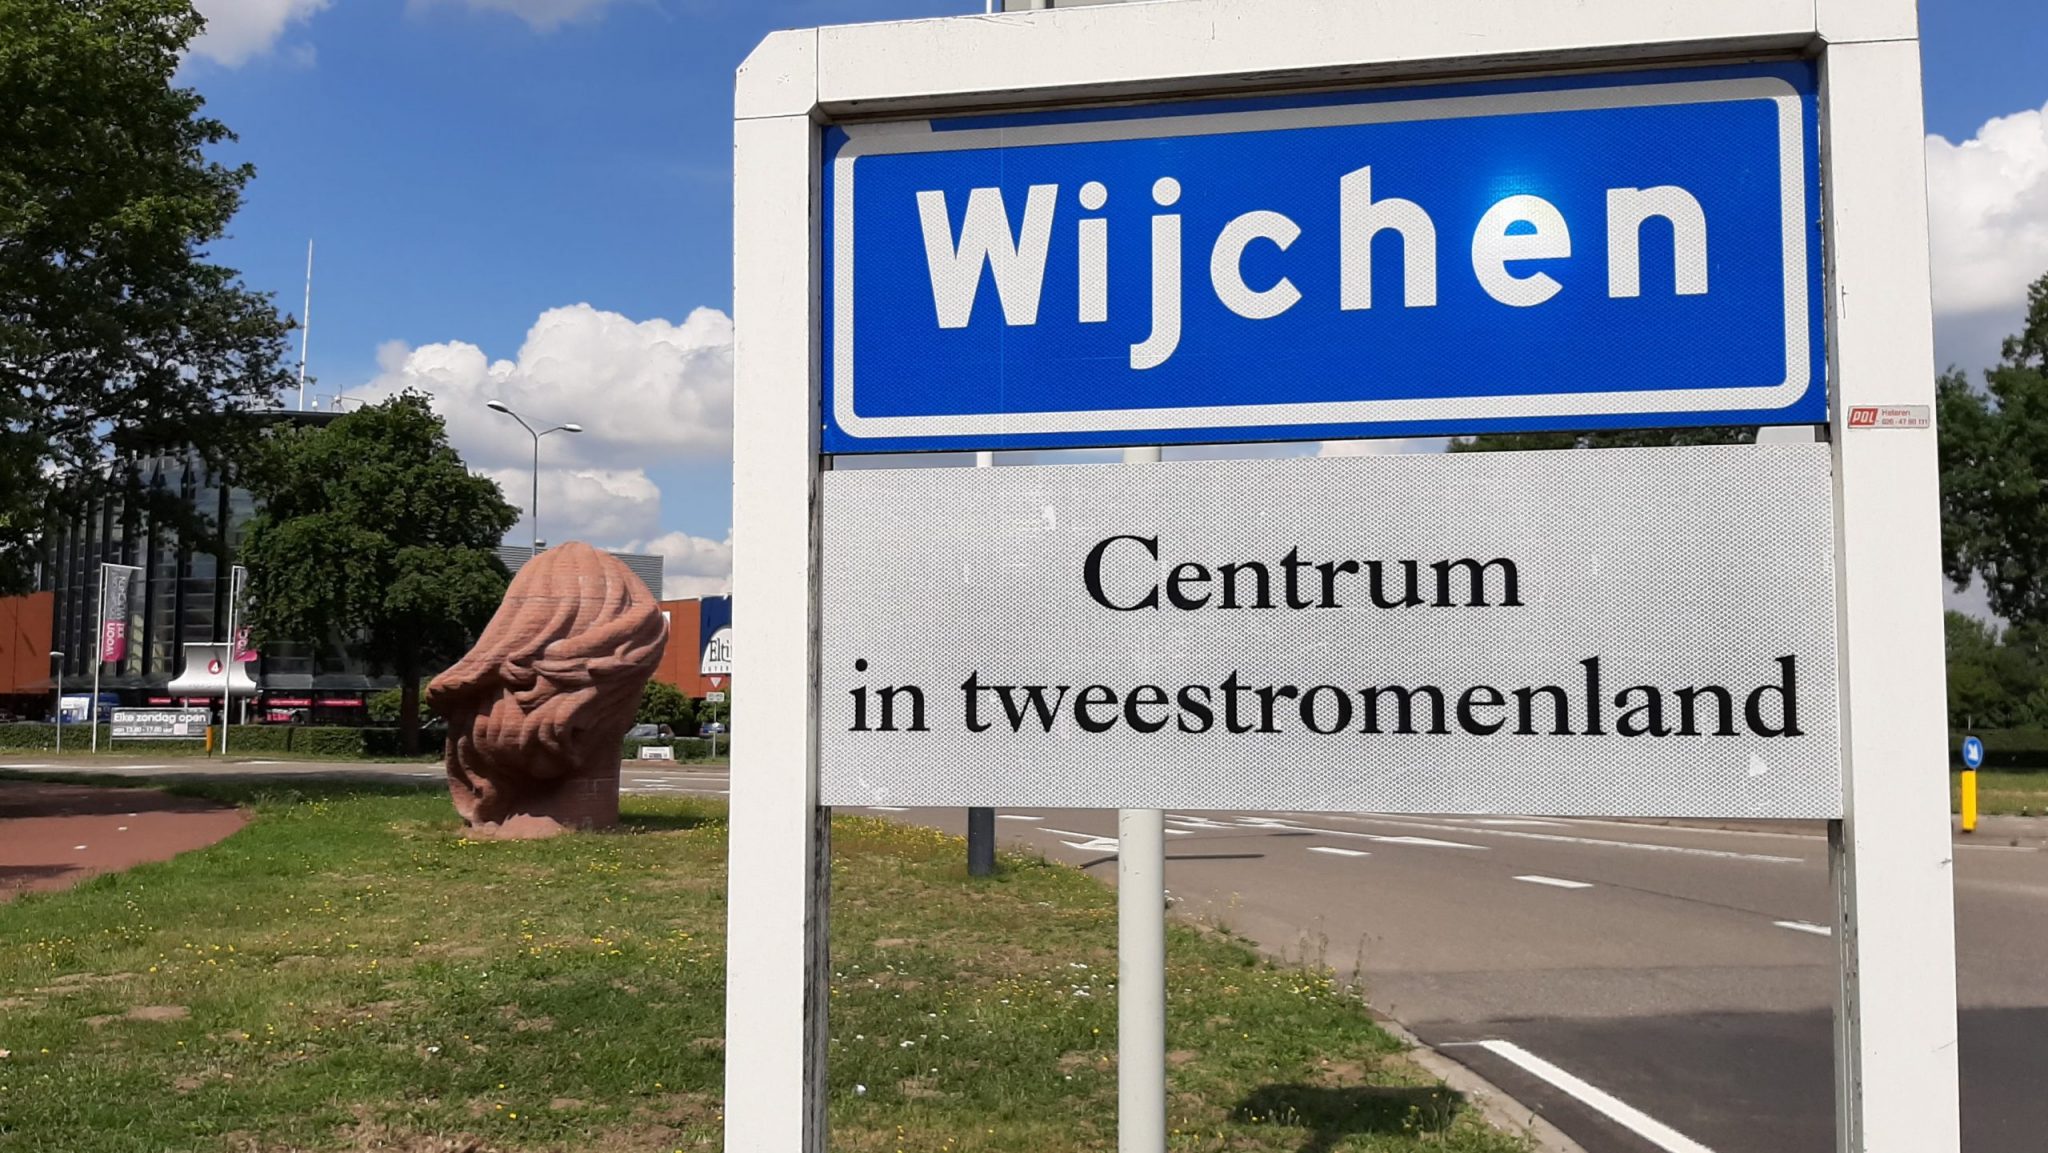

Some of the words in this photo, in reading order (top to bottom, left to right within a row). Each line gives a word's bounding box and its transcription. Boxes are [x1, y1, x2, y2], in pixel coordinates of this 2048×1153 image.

[915, 165, 1709, 371] Wijchen
[1084, 535, 1525, 611] Centrum
[709, 637, 732, 662] Elti
[113, 712, 134, 722] Elke
[136, 712, 177, 724] zondag
[178, 714, 206, 723] open
[849, 658, 930, 732] in
[961, 655, 1805, 738] tweestromenland
